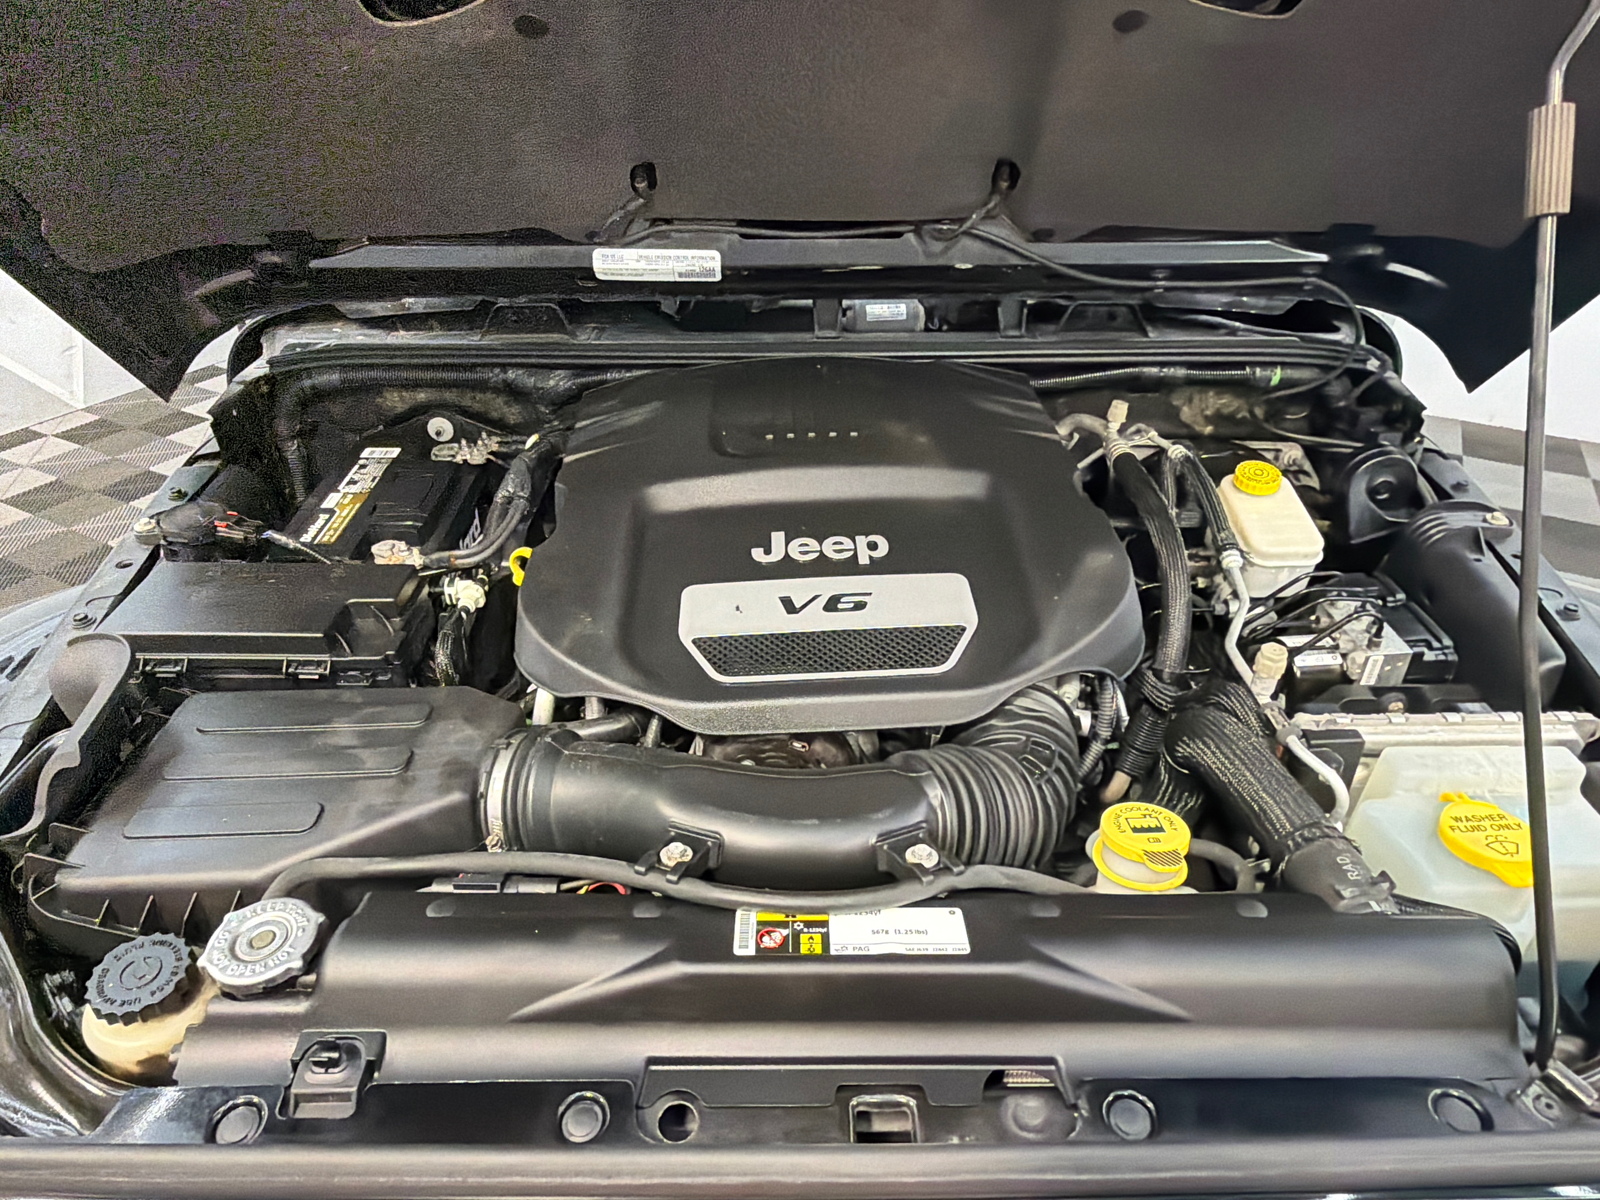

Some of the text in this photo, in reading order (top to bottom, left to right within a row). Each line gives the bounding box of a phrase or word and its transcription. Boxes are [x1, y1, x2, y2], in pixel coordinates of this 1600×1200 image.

[299, 513, 331, 542] DieHard
[751, 531, 889, 565] Jeep
[778, 592, 873, 615] V6
[1112, 806, 1179, 834] ENGINE COOLANT ONLY
[1449, 822, 1524, 833] FLUID ONLY
[1450, 813, 1509, 823] WASHER
[1335, 855, 1362, 881] RAD
[245, 901, 286, 918] KEEP
[225, 963, 266, 977] OPEN
[266, 946, 295, 968] HOT
